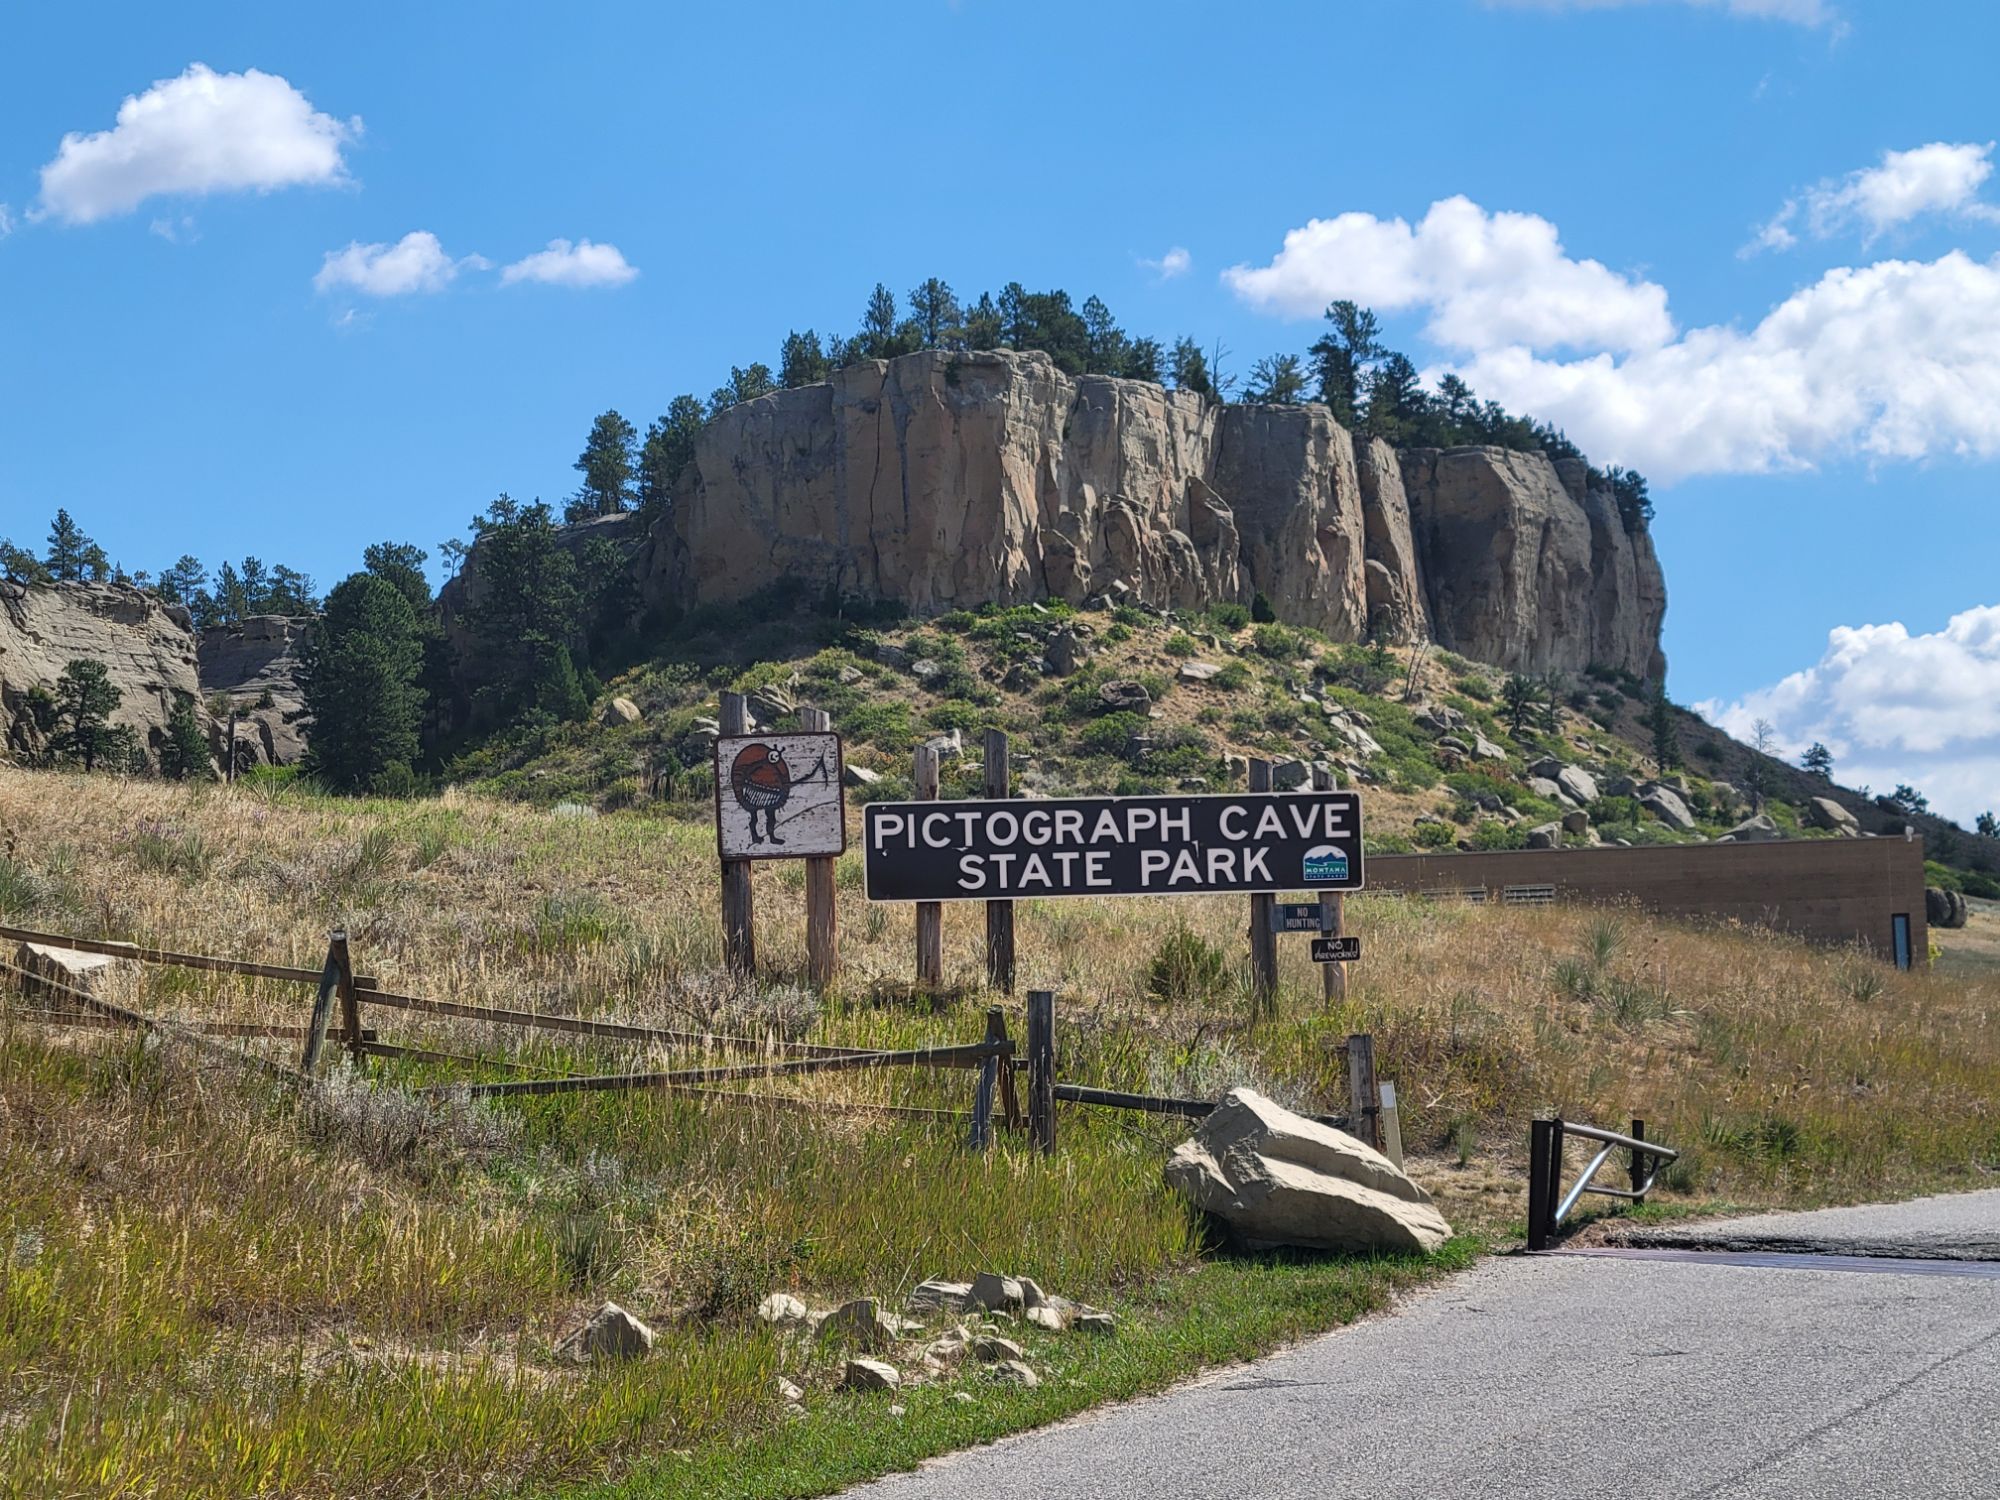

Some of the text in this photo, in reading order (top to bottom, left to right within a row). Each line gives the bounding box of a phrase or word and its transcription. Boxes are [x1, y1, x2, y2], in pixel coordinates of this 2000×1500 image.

[874, 804, 1351, 849] PICTOGRAPH CAVE
[957, 848, 1273, 890] STATE PARK
[1297, 907, 1308, 917] NO
[1286, 918, 1320, 929] HUNTING
[1327, 941, 1343, 950] NO
